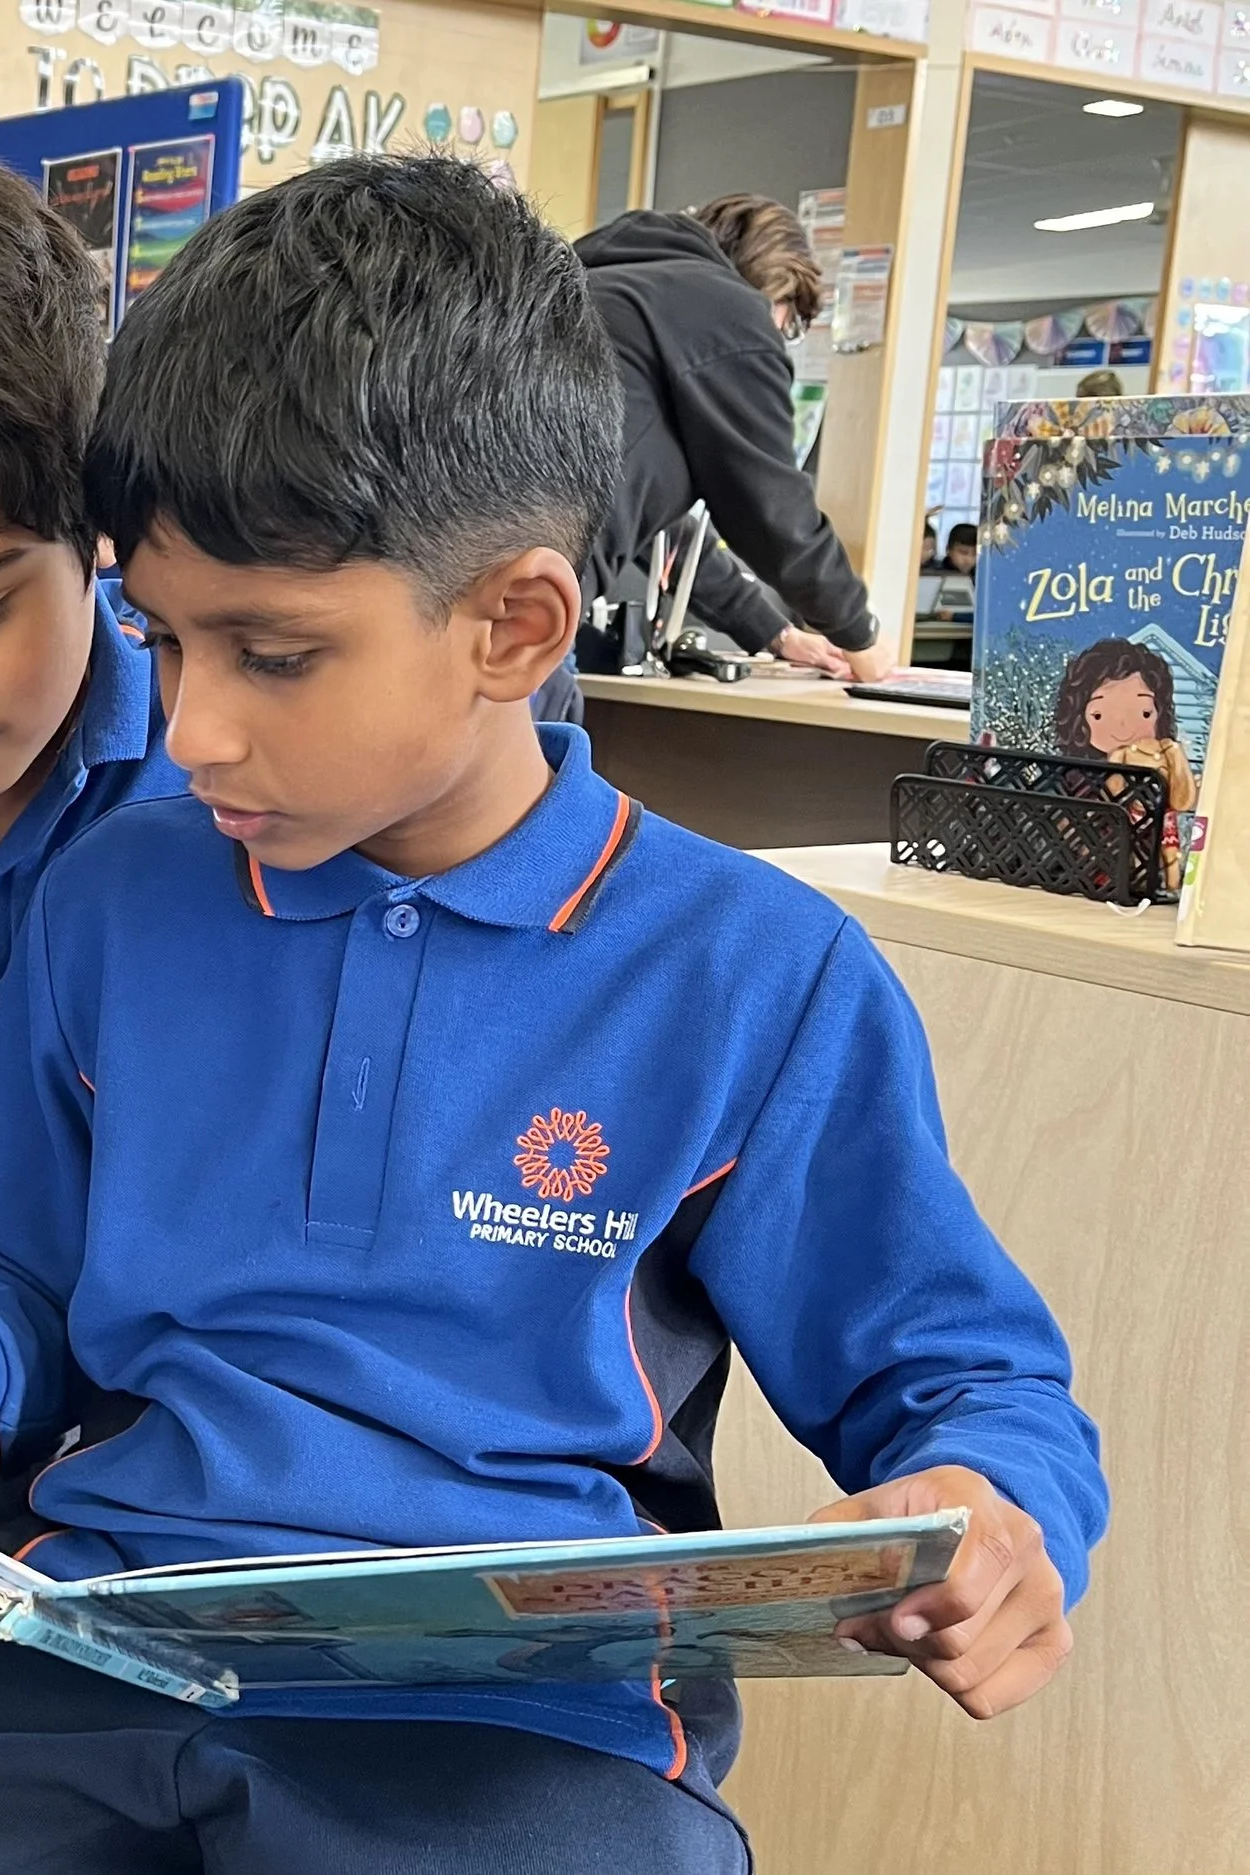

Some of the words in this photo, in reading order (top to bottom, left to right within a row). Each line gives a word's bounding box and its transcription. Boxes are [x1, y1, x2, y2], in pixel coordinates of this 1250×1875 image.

[1077, 492, 1153, 524] Melina
[1169, 525, 1198, 540] Deb
[1026, 562, 1115, 622] Zola
[1124, 556, 1163, 584] and
[1128, 586, 1161, 612] the
[452, 1190, 596, 1235] Wheelers
[604, 1209, 639, 1241] Hill
[470, 1223, 550, 1248] PRIMARY
[553, 1233, 617, 1259] SCHOOL
